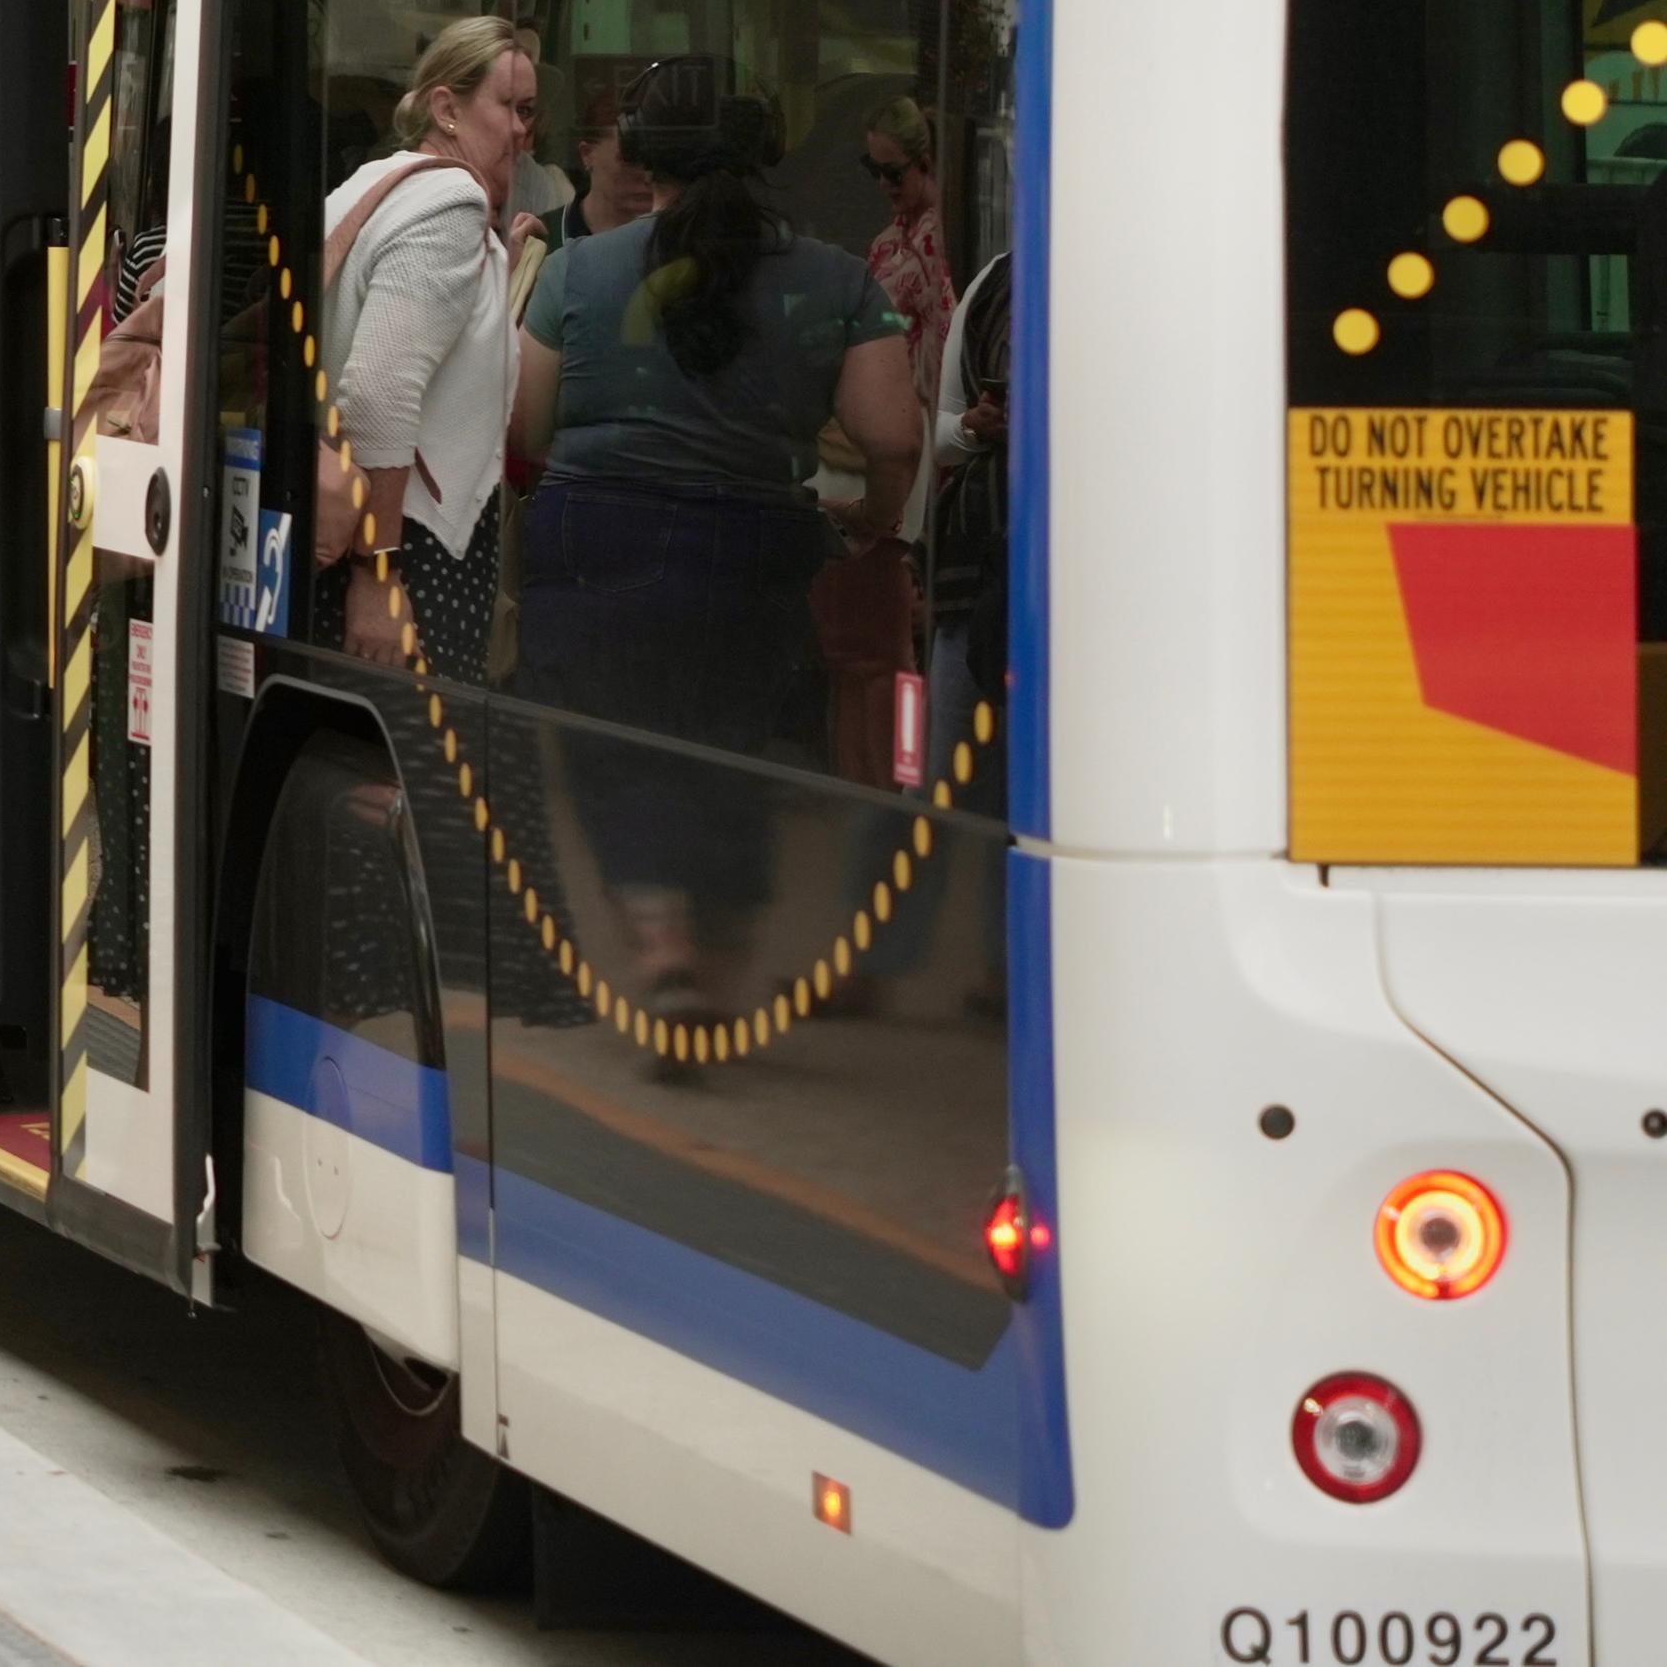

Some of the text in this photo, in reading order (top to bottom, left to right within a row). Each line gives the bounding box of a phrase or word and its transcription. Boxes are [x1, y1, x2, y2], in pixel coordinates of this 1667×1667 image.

[1309, 414, 1610, 461] DO NOT OVERTAKE
[1315, 467, 1605, 514] TURNING VEHICLE
[1221, 1606, 1558, 1666] Q100922
